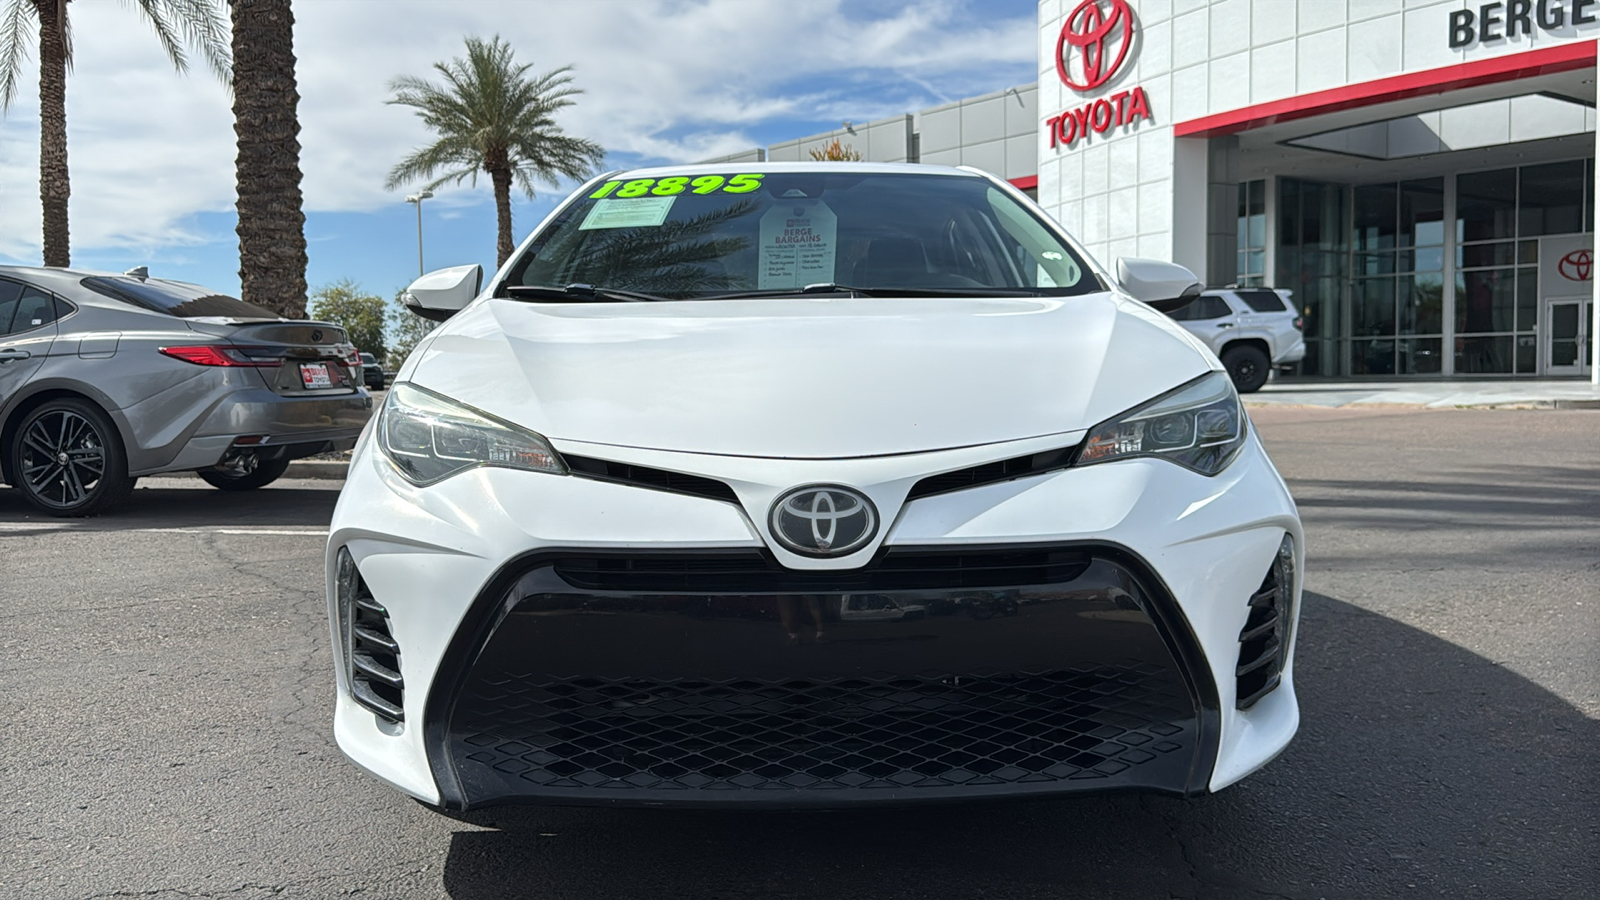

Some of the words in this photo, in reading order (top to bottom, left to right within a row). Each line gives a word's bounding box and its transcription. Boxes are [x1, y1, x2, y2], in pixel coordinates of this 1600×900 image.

[1449, 0, 1596, 48] BERGE
[1046, 86, 1150, 149] TOYOTA
[589, 174, 765, 198] 18895
[775, 235, 821, 244] BARGAINS
[784, 228, 813, 236] BERGE
